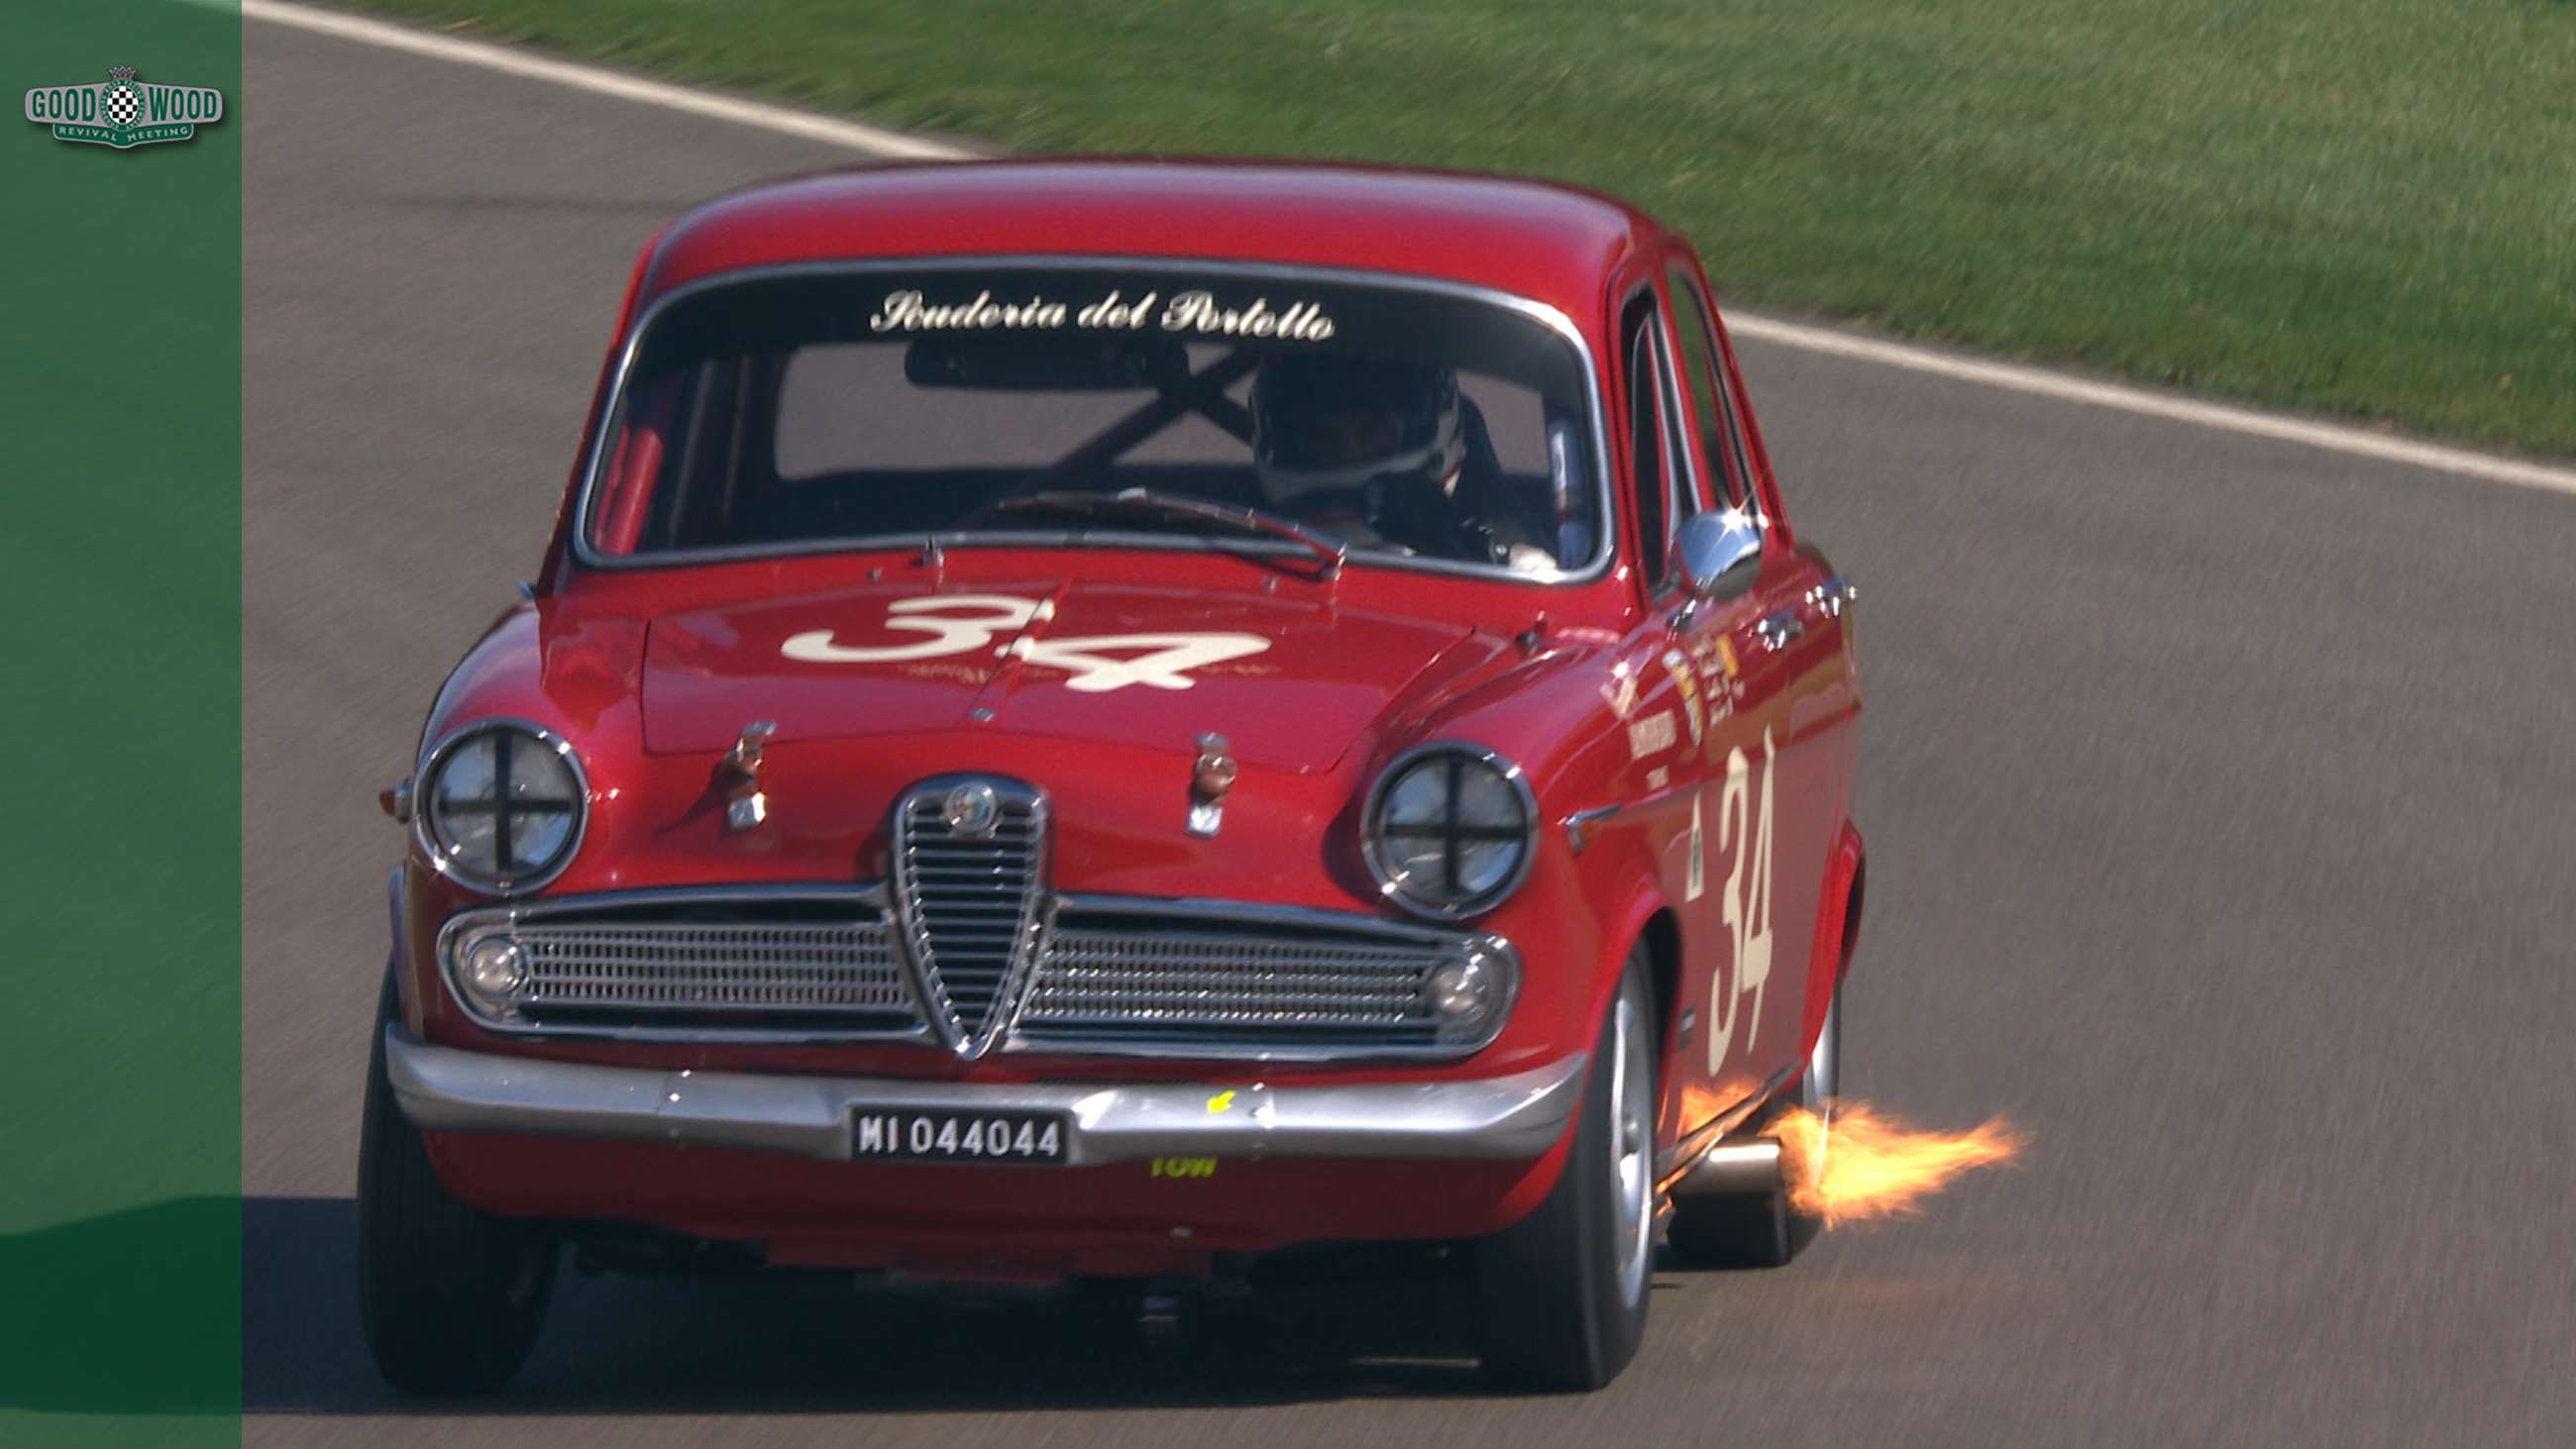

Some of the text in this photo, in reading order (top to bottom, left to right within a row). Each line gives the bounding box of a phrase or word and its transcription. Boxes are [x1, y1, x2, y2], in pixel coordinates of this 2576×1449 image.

[869, 289, 1335, 341] Scuderia del Portello
[780, 594, 1272, 692] 34
[1708, 723, 1774, 1078] 34
[858, 1115, 1060, 1157] MI 044044
